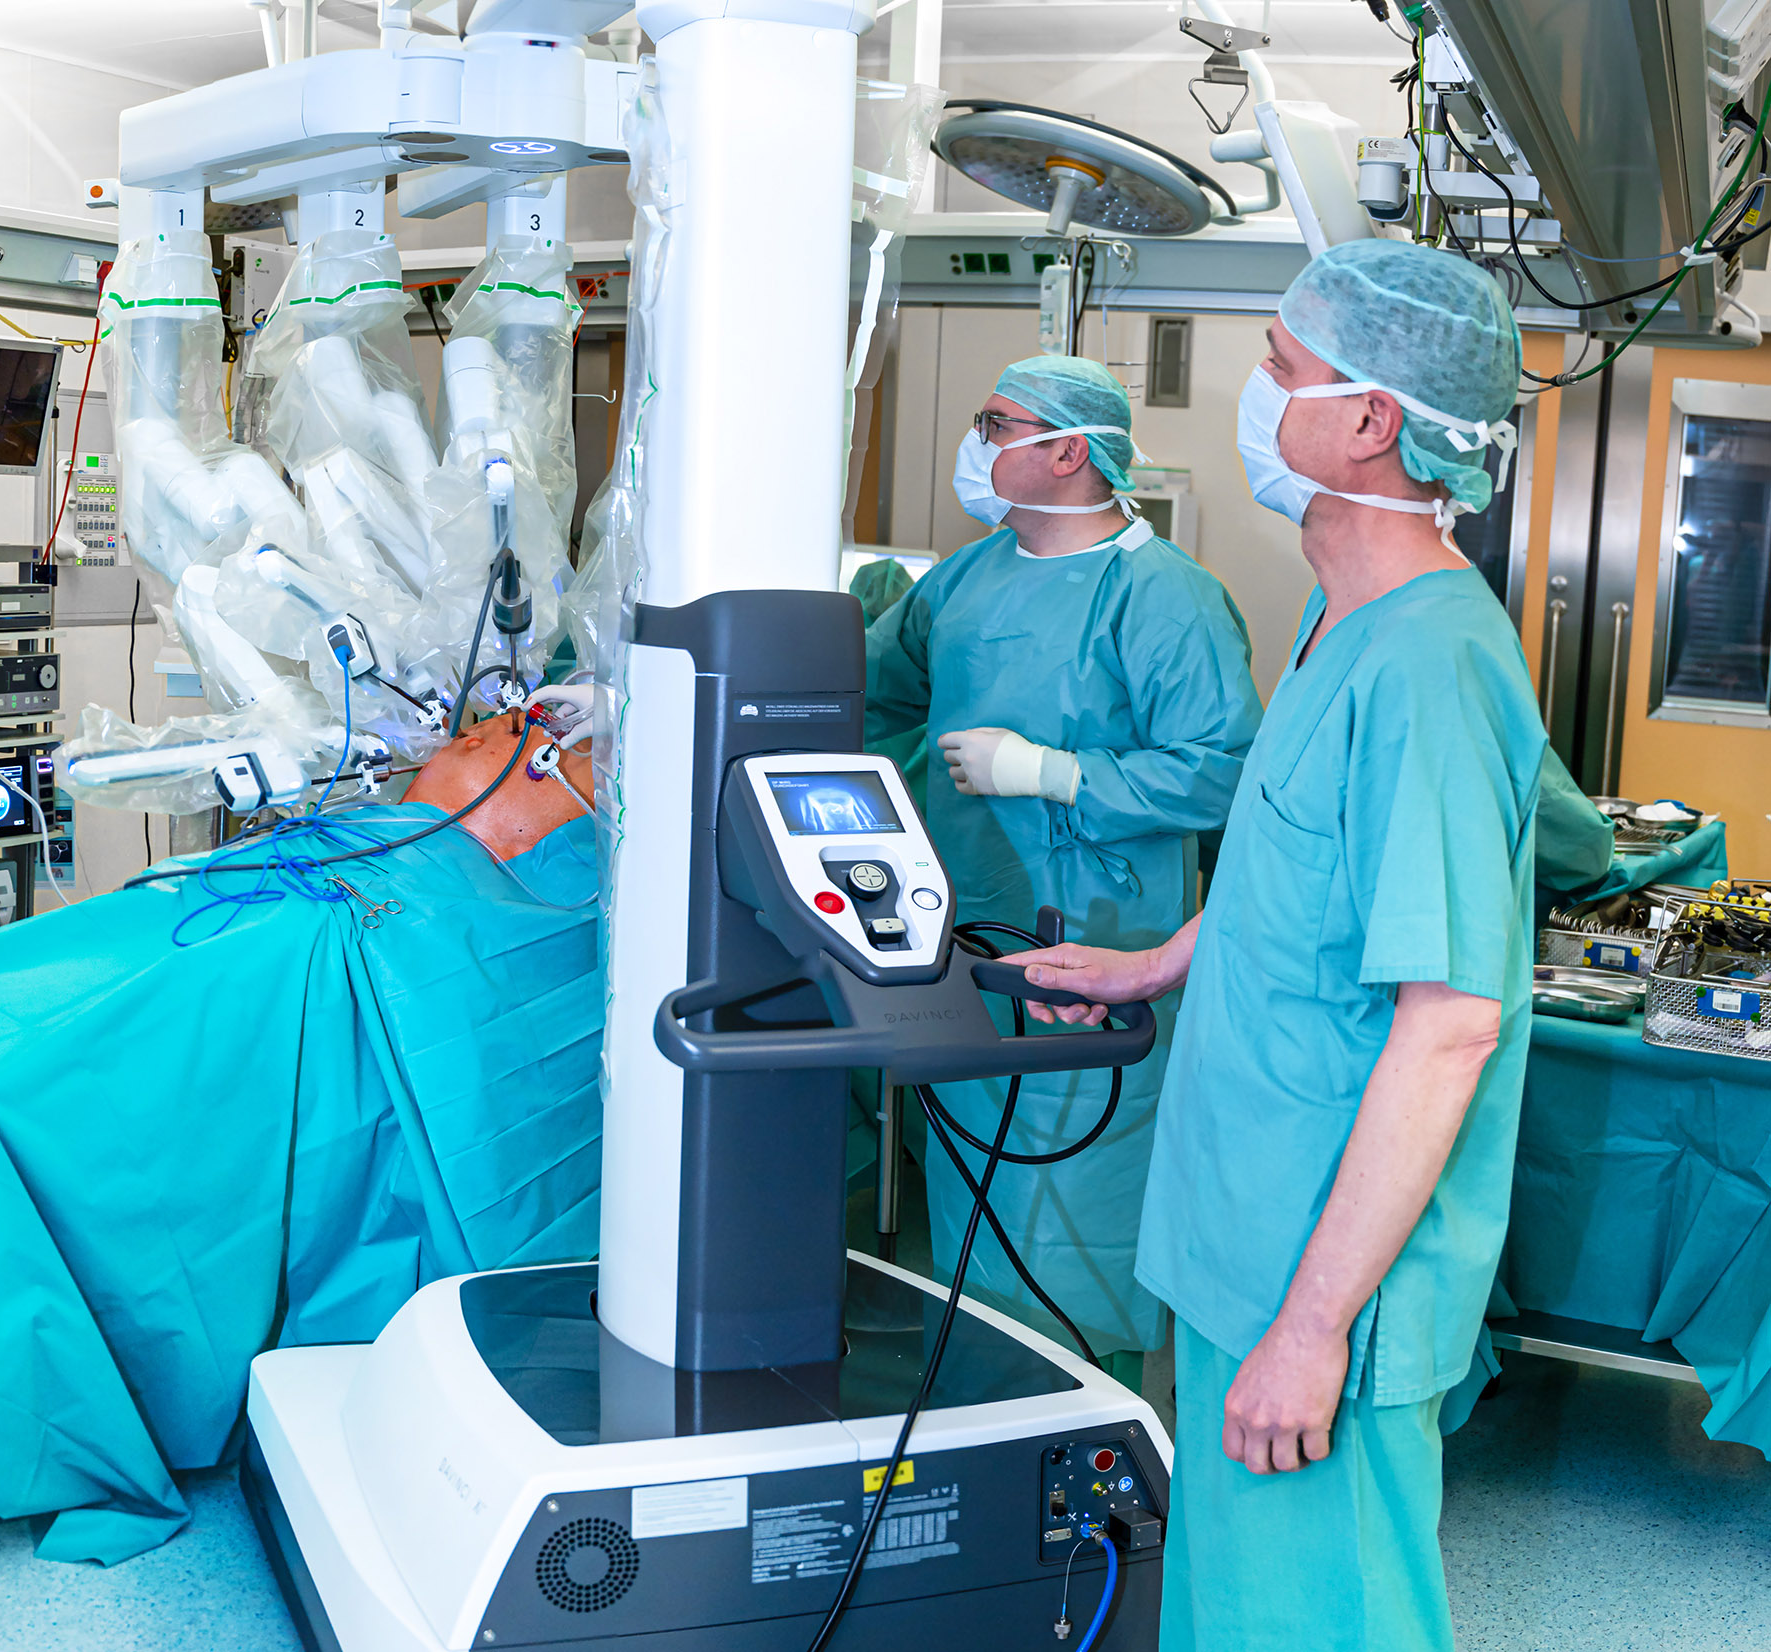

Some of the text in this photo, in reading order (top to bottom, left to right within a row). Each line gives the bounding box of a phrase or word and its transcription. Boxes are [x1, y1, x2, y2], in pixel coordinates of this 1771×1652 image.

[1368, 140, 1379, 149] CE
[178, 208, 184, 226] 1
[354, 209, 364, 227] 2
[530, 214, 541, 231] 3
